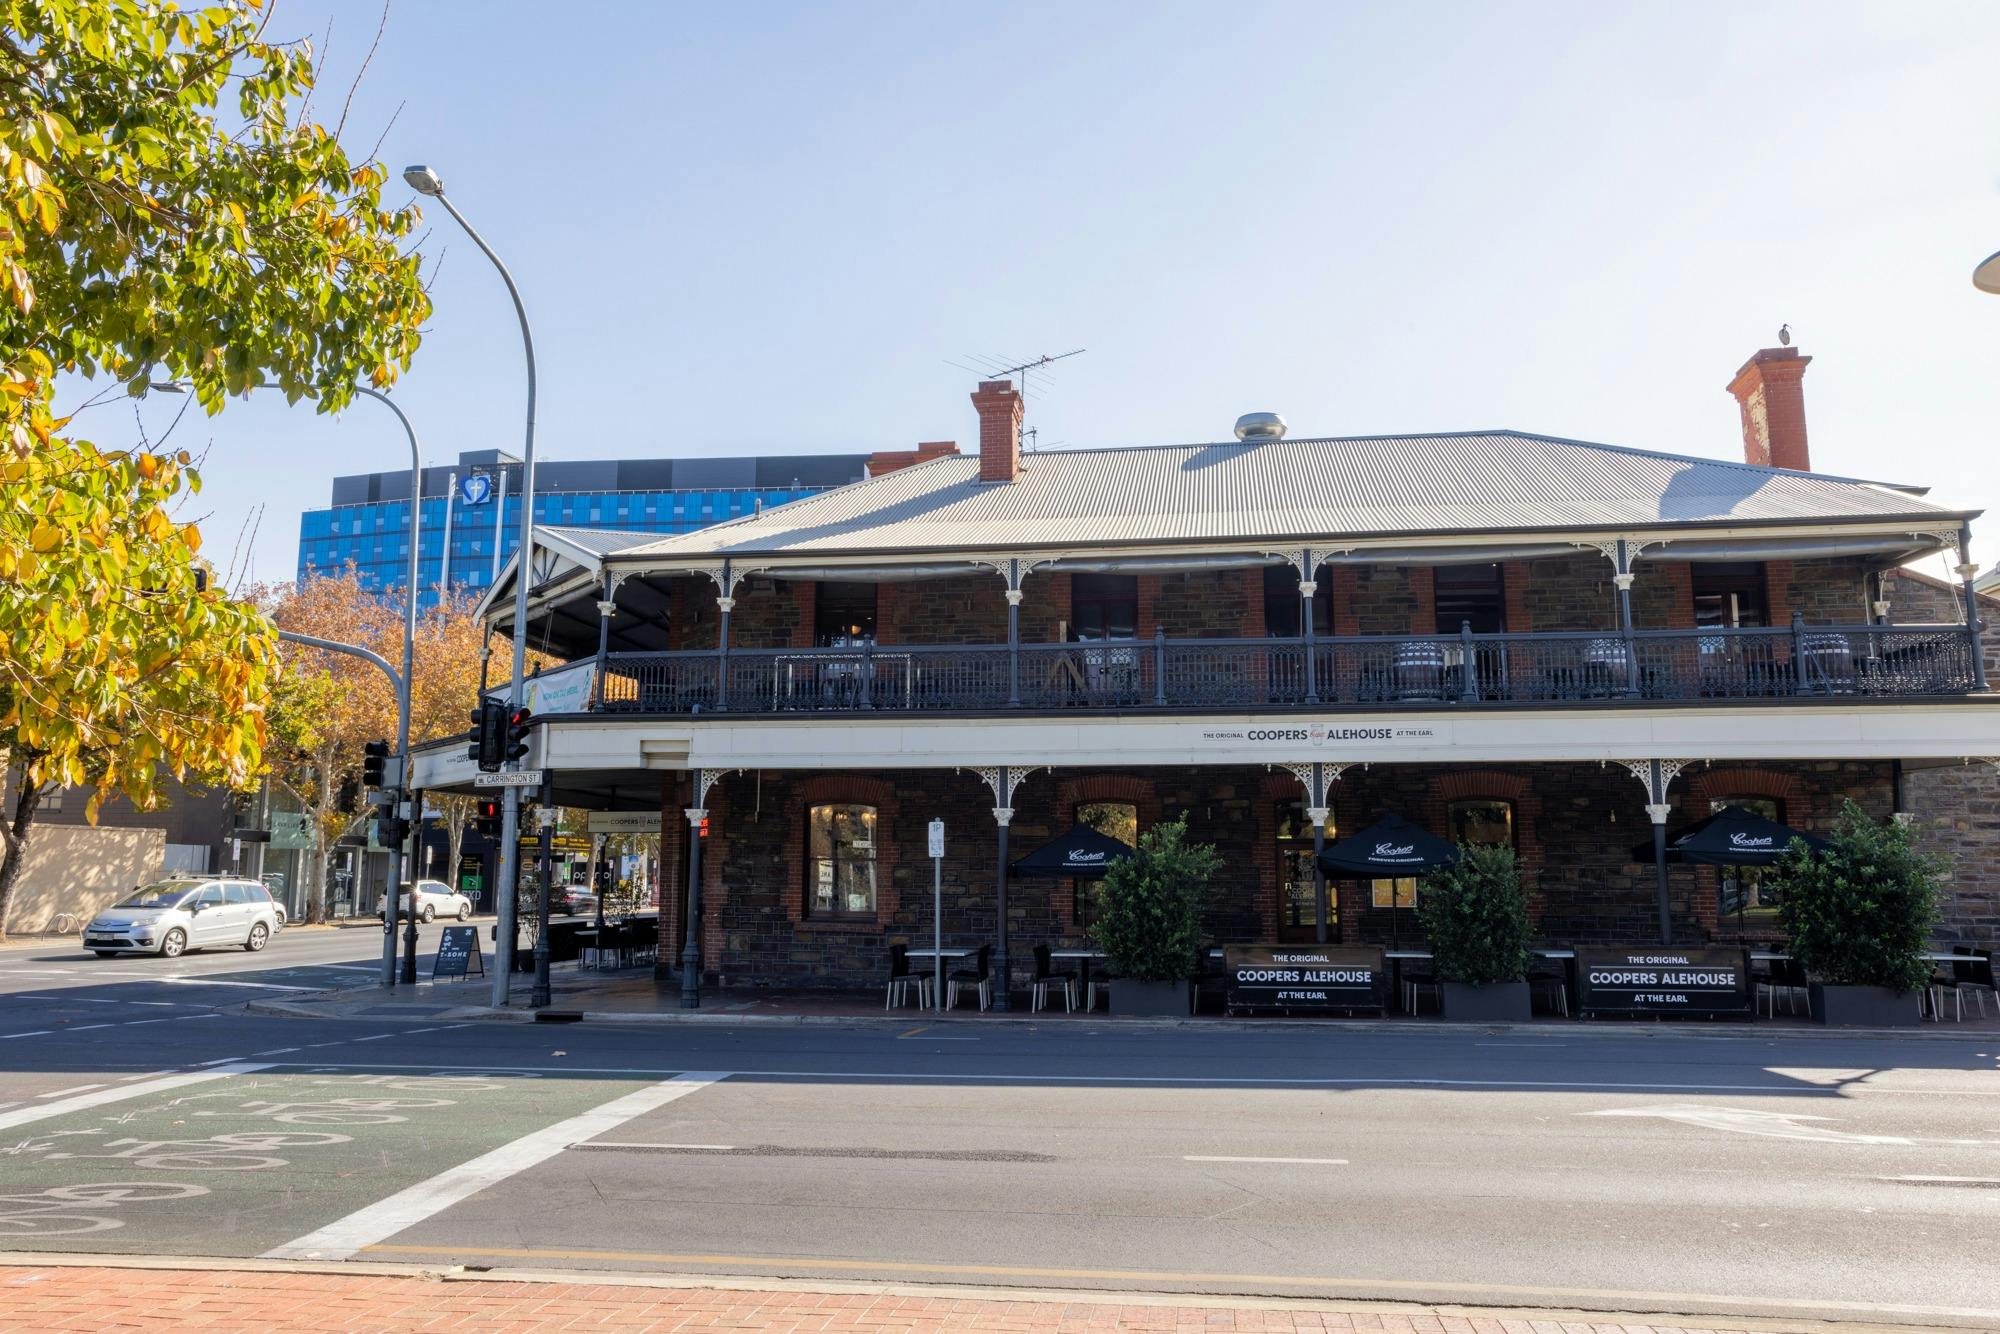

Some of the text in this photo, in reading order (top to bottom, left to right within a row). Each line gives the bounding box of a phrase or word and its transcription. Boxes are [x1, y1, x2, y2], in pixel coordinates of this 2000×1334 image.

[1248, 730, 1308, 740] COOPERS
[1327, 729, 1392, 740] ALEHOUSE
[486, 774, 537, 784] CARRINGTON ST
[1731, 832, 1773, 846] Coopers
[1069, 849, 1105, 861] Coopers
[1376, 842, 1414, 856] Coopers
[1627, 956, 1689, 964] THE ORIGINAL
[1237, 970, 1371, 982] COOPERS ALEHOUSE
[1590, 973, 1736, 985] COOPERS ALEHOUSE
[1634, 994, 1645, 1002] AT
